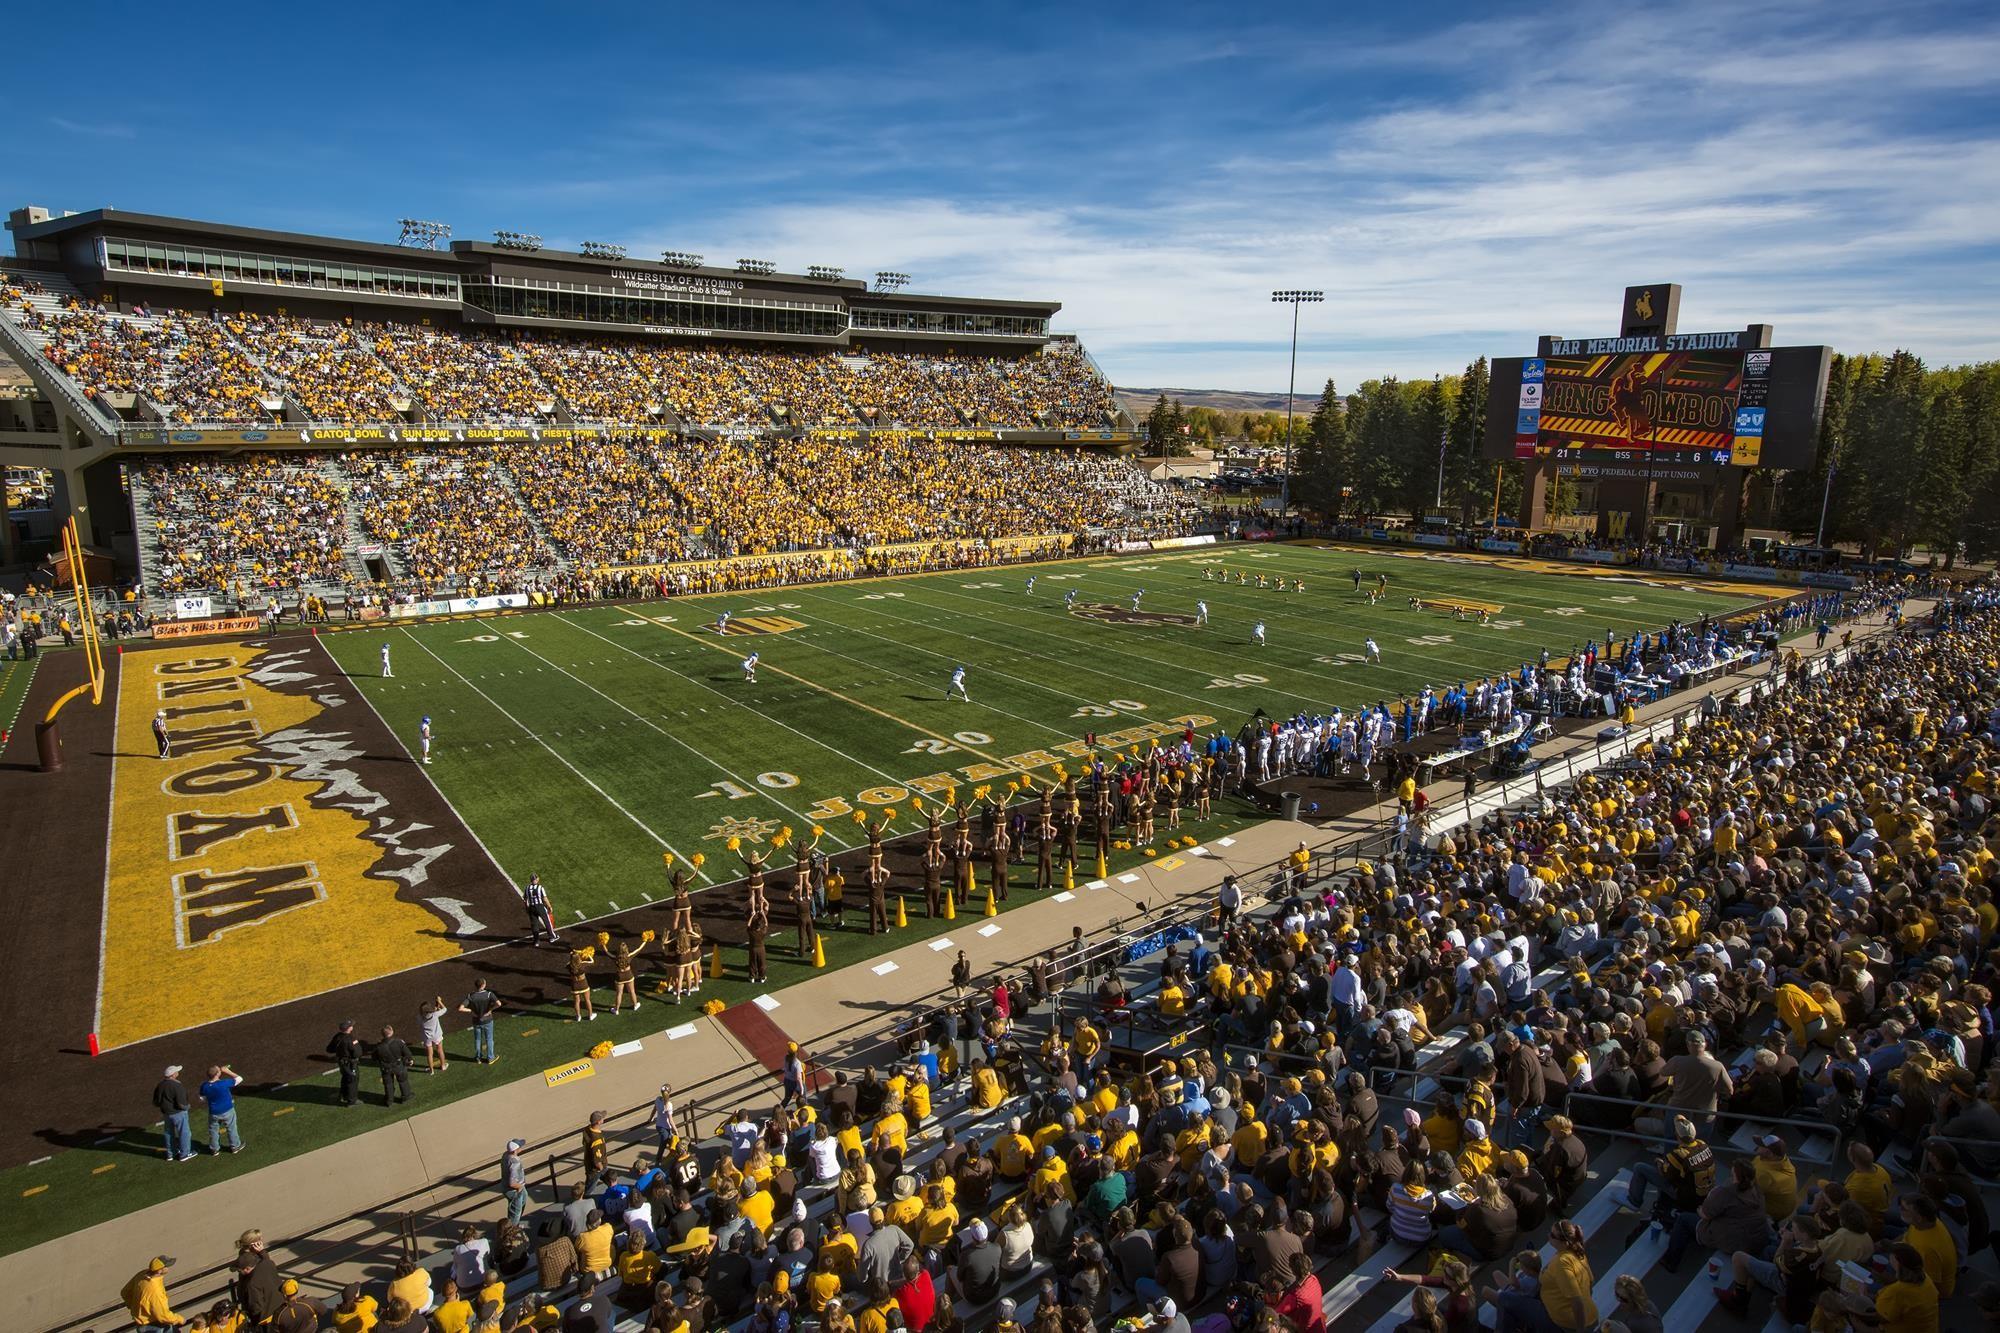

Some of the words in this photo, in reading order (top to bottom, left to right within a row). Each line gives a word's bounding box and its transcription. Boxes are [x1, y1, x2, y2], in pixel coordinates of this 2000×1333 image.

[611, 270, 676, 284] UNIVERSITY
[678, 276, 692, 285] OF
[694, 277, 744, 290] WYOMING
[624, 280, 658, 290] Wildcatter
[660, 283, 687, 292] Stadium
[688, 285, 704, 294] Club
[711, 288, 732, 296] Suites
[103, 295, 112, 303] 21
[1551, 340, 1580, 356] WAR
[1587, 336, 1660, 353] MEMORIAL
[1666, 332, 1740, 350] STADIUM
[178, 433, 197, 441] Ford
[246, 433, 264, 441] Ford
[314, 429, 351, 439] GATOR
[354, 429, 385, 438] BOWL
[402, 429, 422, 438] SUN
[425, 429, 452, 438] BOWL
[468, 430, 499, 438] SUGAR
[503, 430, 528, 438] BOWL
[543, 430, 572, 438] FIESTA
[840, 430, 860, 438] BOWL
[1556, 449, 1568, 458] 21
[1693, 453, 1701, 462] 6
[1714, 451, 1729, 465] AF
[1581, 467, 1599, 475] WYO
[1601, 468, 1637, 476] FEDERAL
[1638, 469, 1669, 477] CREDIT
[1670, 471, 1701, 479] UNION
[156, 624, 189, 636] Black
[191, 621, 216, 633] Hills
[217, 618, 257, 632] Energy
[1208, 673, 1270, 689] 40
[1080, 698, 1148, 718] 30
[914, 731, 995, 756] 20
[805, 749, 1066, 820] JONAH
[1050, 715, 1218, 758] FIELD
[709, 771, 801, 800] 10
[153, 656, 328, 950] WYOMING
[1171, 1033, 1187, 1048] G-H
[549, 1062, 591, 1083] COWBOYS
[679, 1160, 698, 1184] 16
